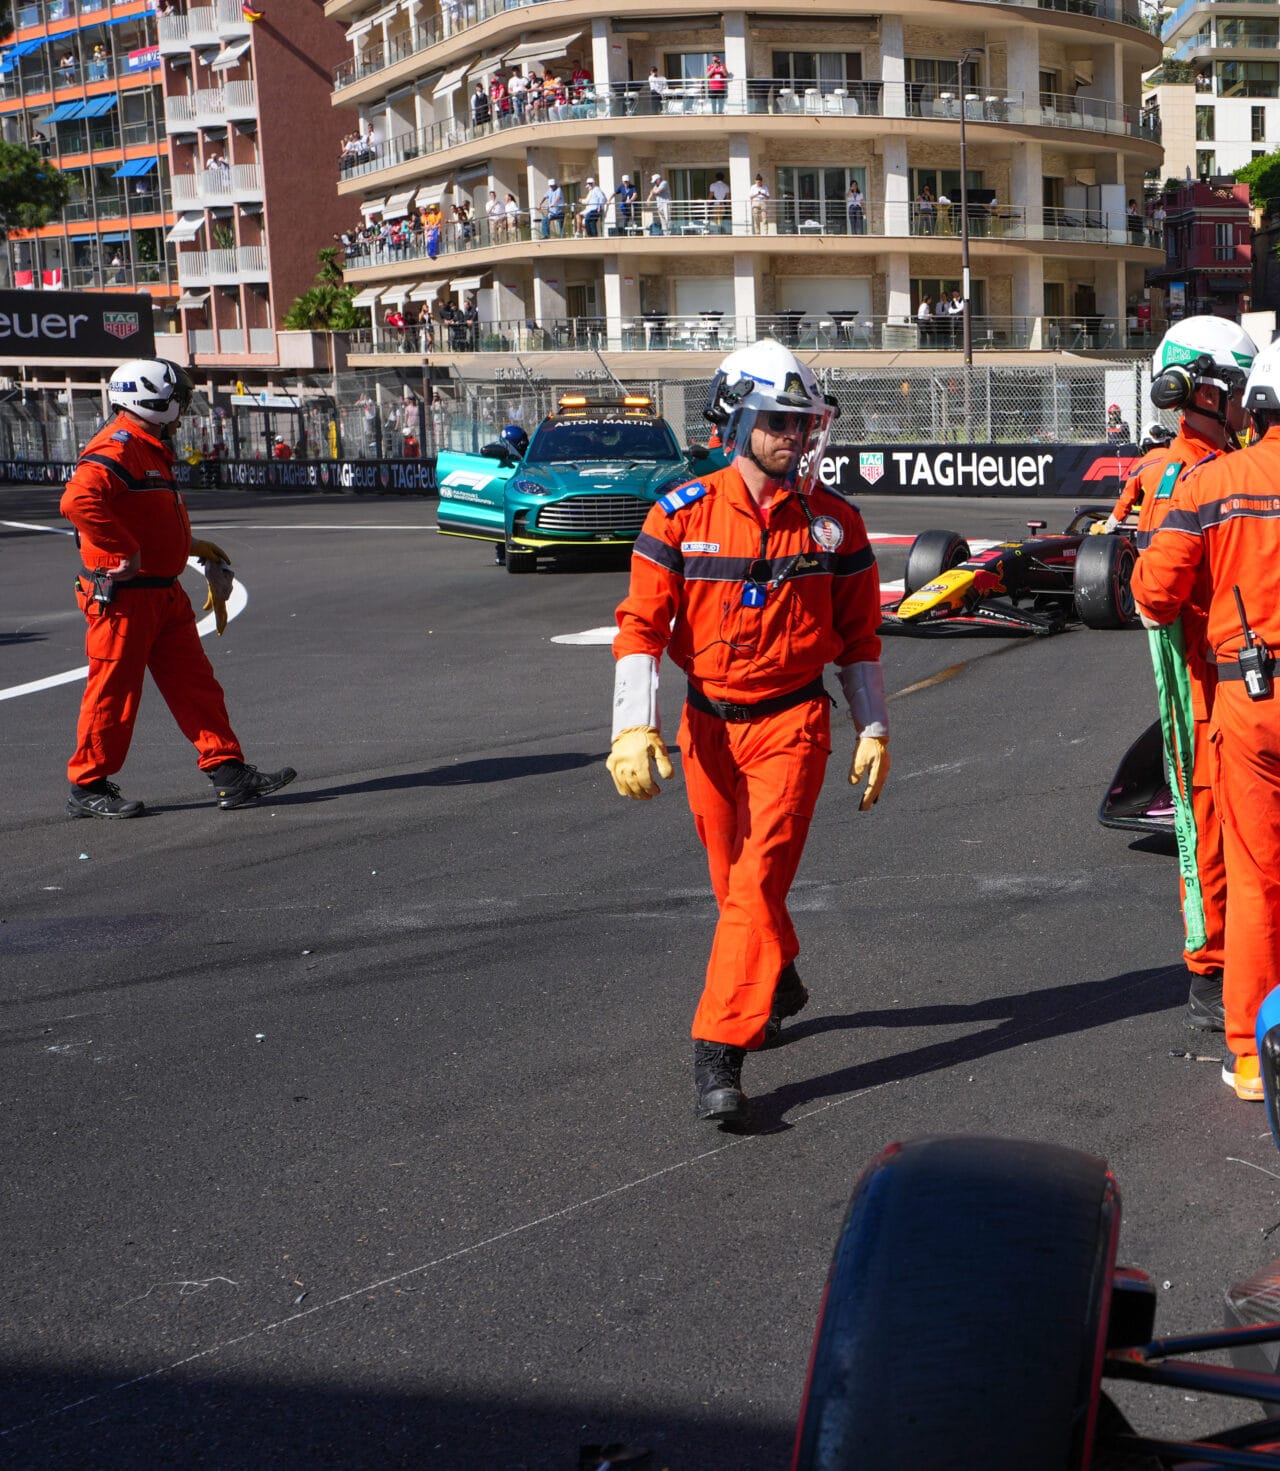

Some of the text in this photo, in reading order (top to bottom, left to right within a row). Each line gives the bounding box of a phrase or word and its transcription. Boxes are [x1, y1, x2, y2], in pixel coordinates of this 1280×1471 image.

[105, 324, 138, 334] HEUER
[1166, 346, 1191, 363] ACM
[554, 419, 653, 428] ASTON MARTIN
[863, 455, 882, 464] TAG
[861, 466, 883, 481] HEUER
[892, 453, 1053, 487] TAGHeuer
[1220, 498, 1272, 514] AUTOMOBILE
[750, 587, 757, 605] 1
